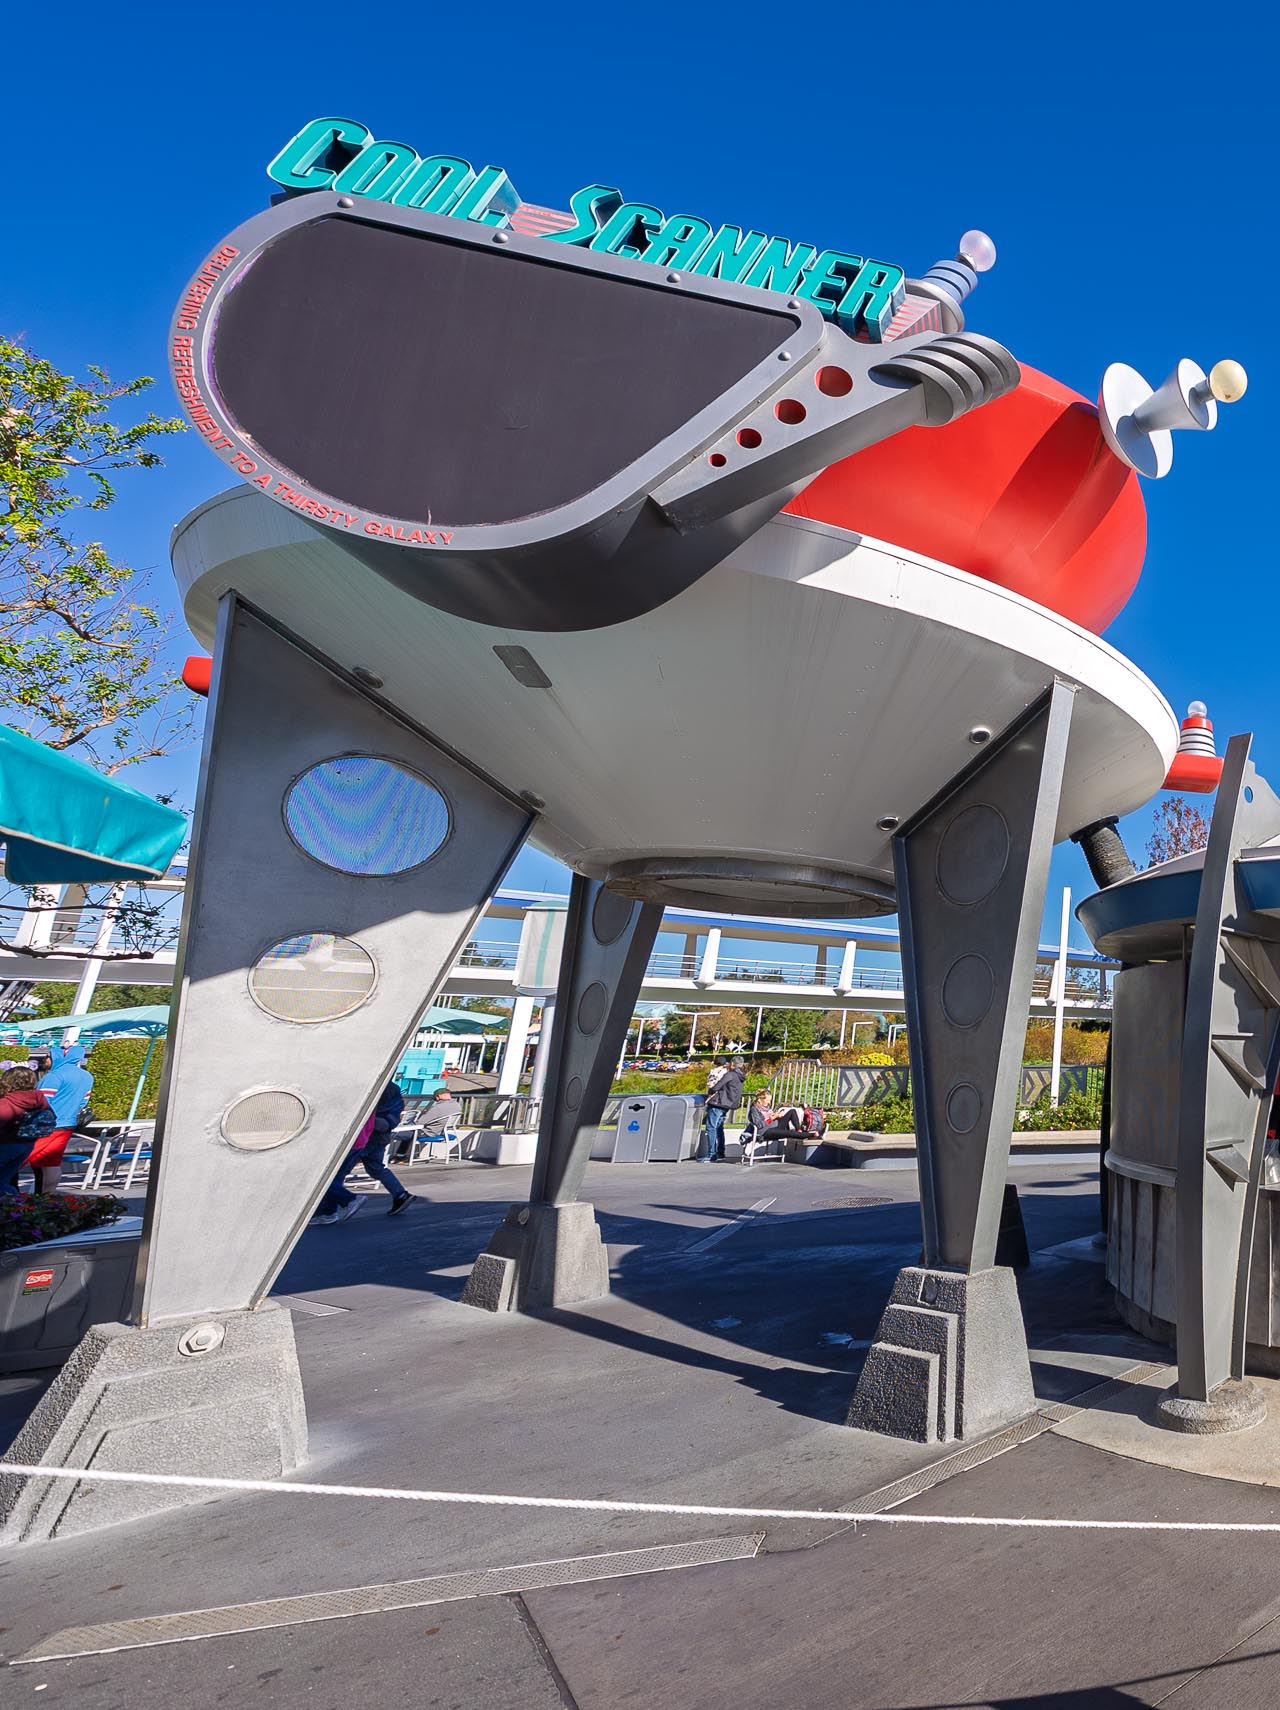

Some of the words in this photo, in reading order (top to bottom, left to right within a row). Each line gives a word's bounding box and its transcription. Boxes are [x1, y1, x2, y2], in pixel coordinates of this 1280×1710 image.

[267, 116, 518, 229] COOL
[540, 184, 905, 338] SCANNER
[176, 243, 241, 331] DELIVERING
[172, 335, 234, 451] REFRESHMENT
[230, 451, 258, 475] TO
[253, 473, 273, 489] A
[273, 481, 359, 528] THIRSTY
[363, 520, 454, 545] GALAXY
